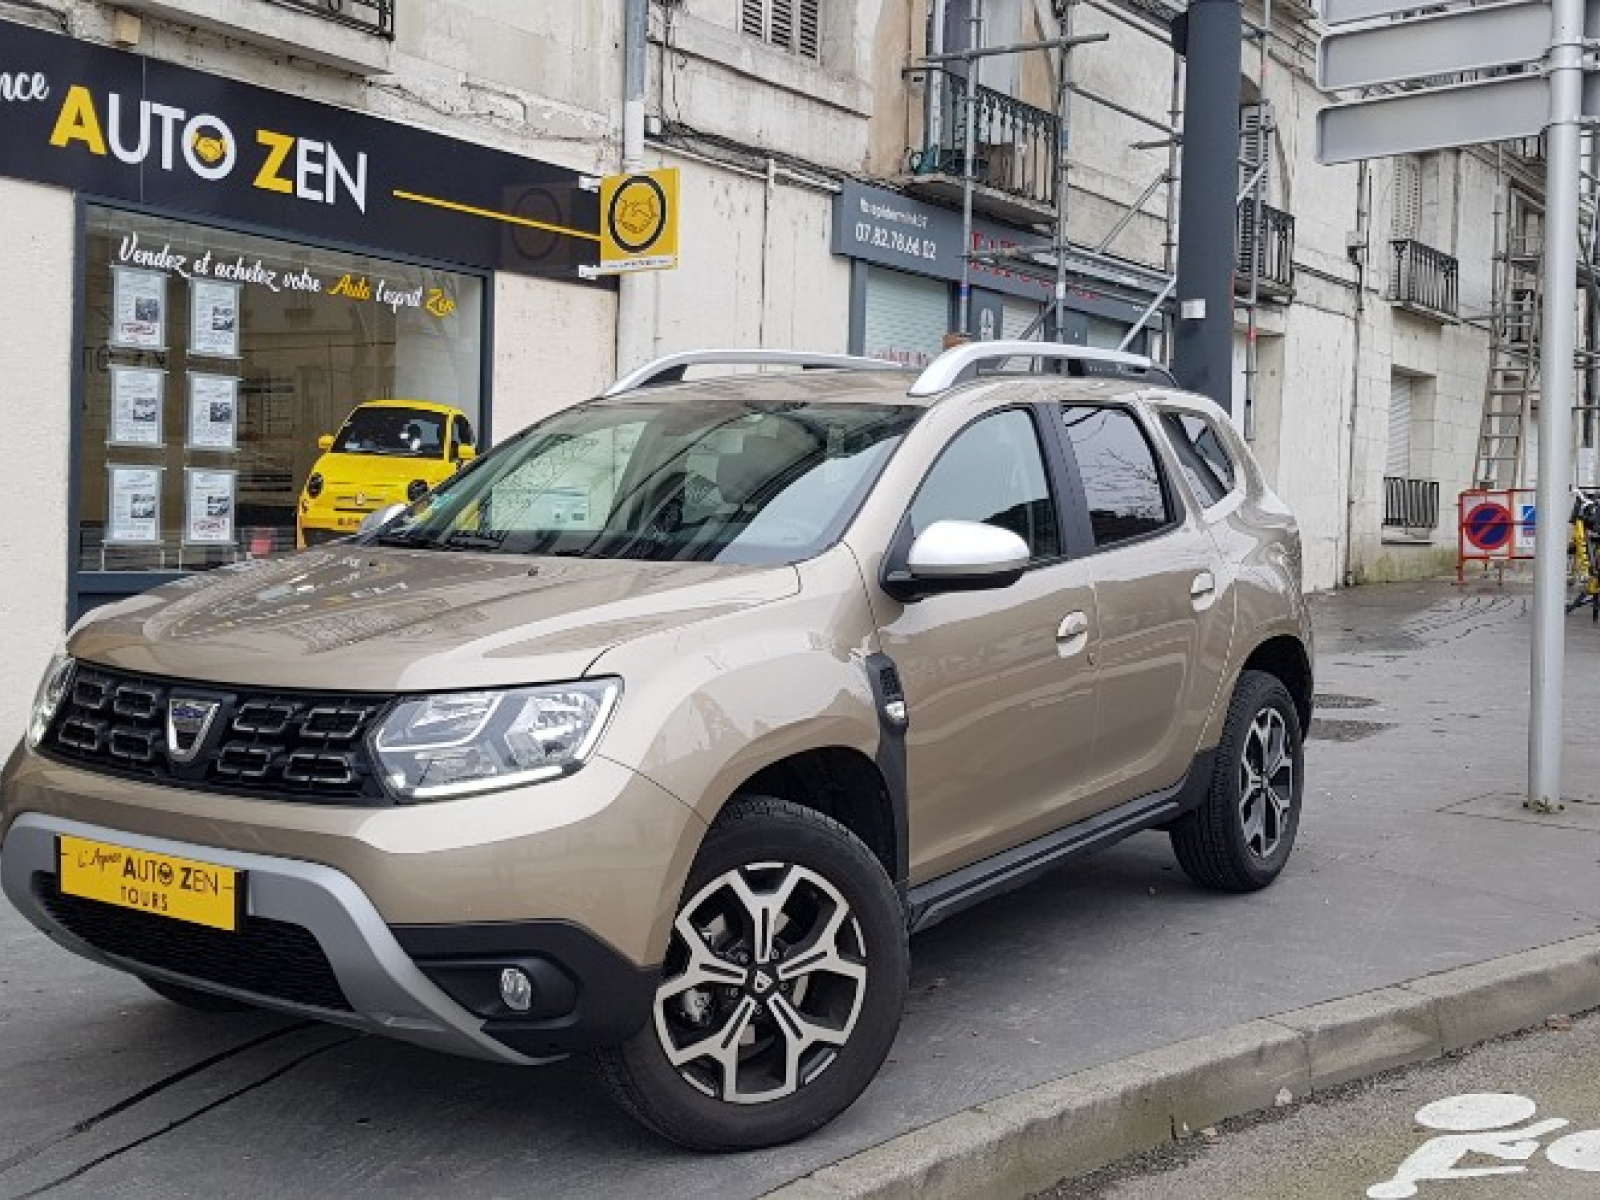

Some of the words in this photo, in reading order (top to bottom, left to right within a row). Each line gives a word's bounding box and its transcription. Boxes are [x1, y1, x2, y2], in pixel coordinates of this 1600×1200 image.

[49, 84, 237, 180] AUTO
[252, 129, 368, 214] ZEN
[119, 231, 190, 278] Vendez
[193, 250, 211, 275] et
[214, 256, 281, 292] achetez
[282, 267, 321, 292] votre
[326, 274, 371, 300] Auto
[120, 885, 168, 911] TOURS
[122, 855, 174, 887] AUTO
[179, 866, 218, 896] ZEN
